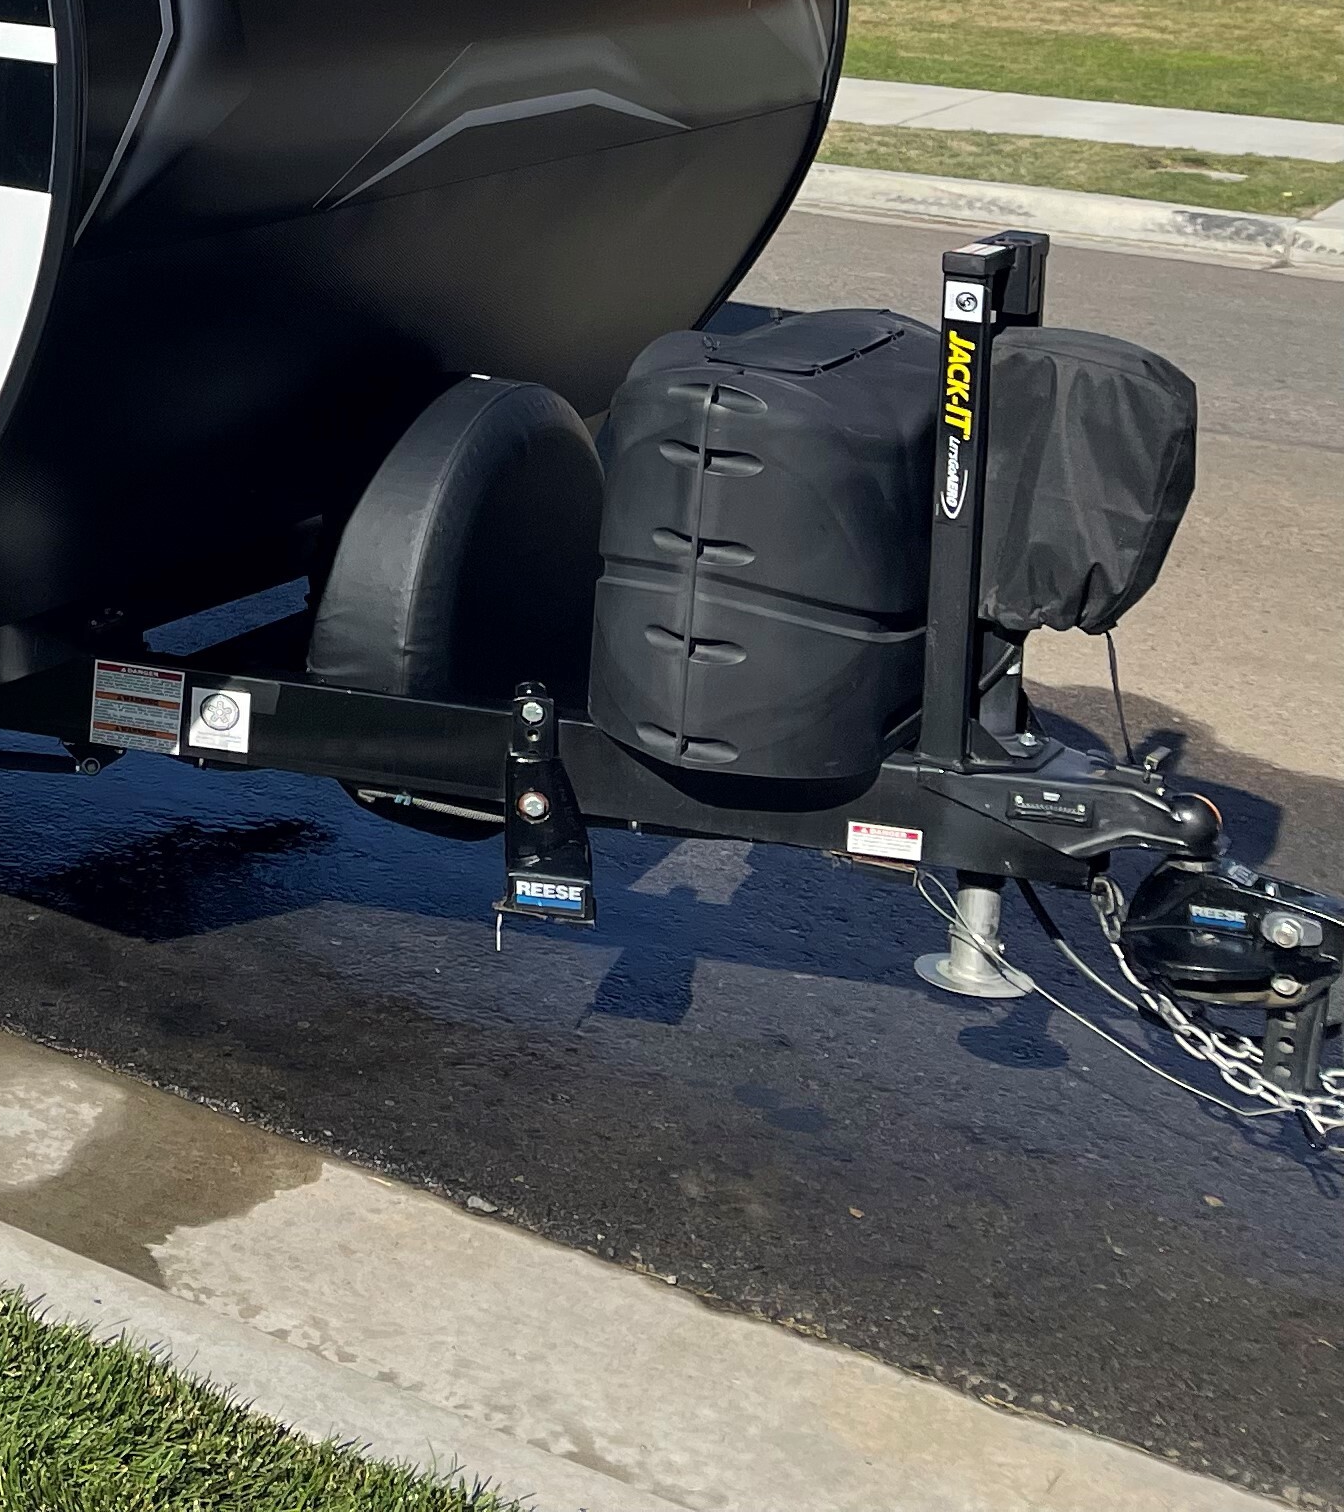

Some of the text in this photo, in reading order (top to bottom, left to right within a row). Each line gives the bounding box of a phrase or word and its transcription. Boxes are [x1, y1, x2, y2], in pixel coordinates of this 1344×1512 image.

[945, 330, 976, 436] JACK-IT
[127, 668, 159, 678] DANGER
[516, 880, 584, 901] REESE
[1189, 904, 1248, 923] REESE
